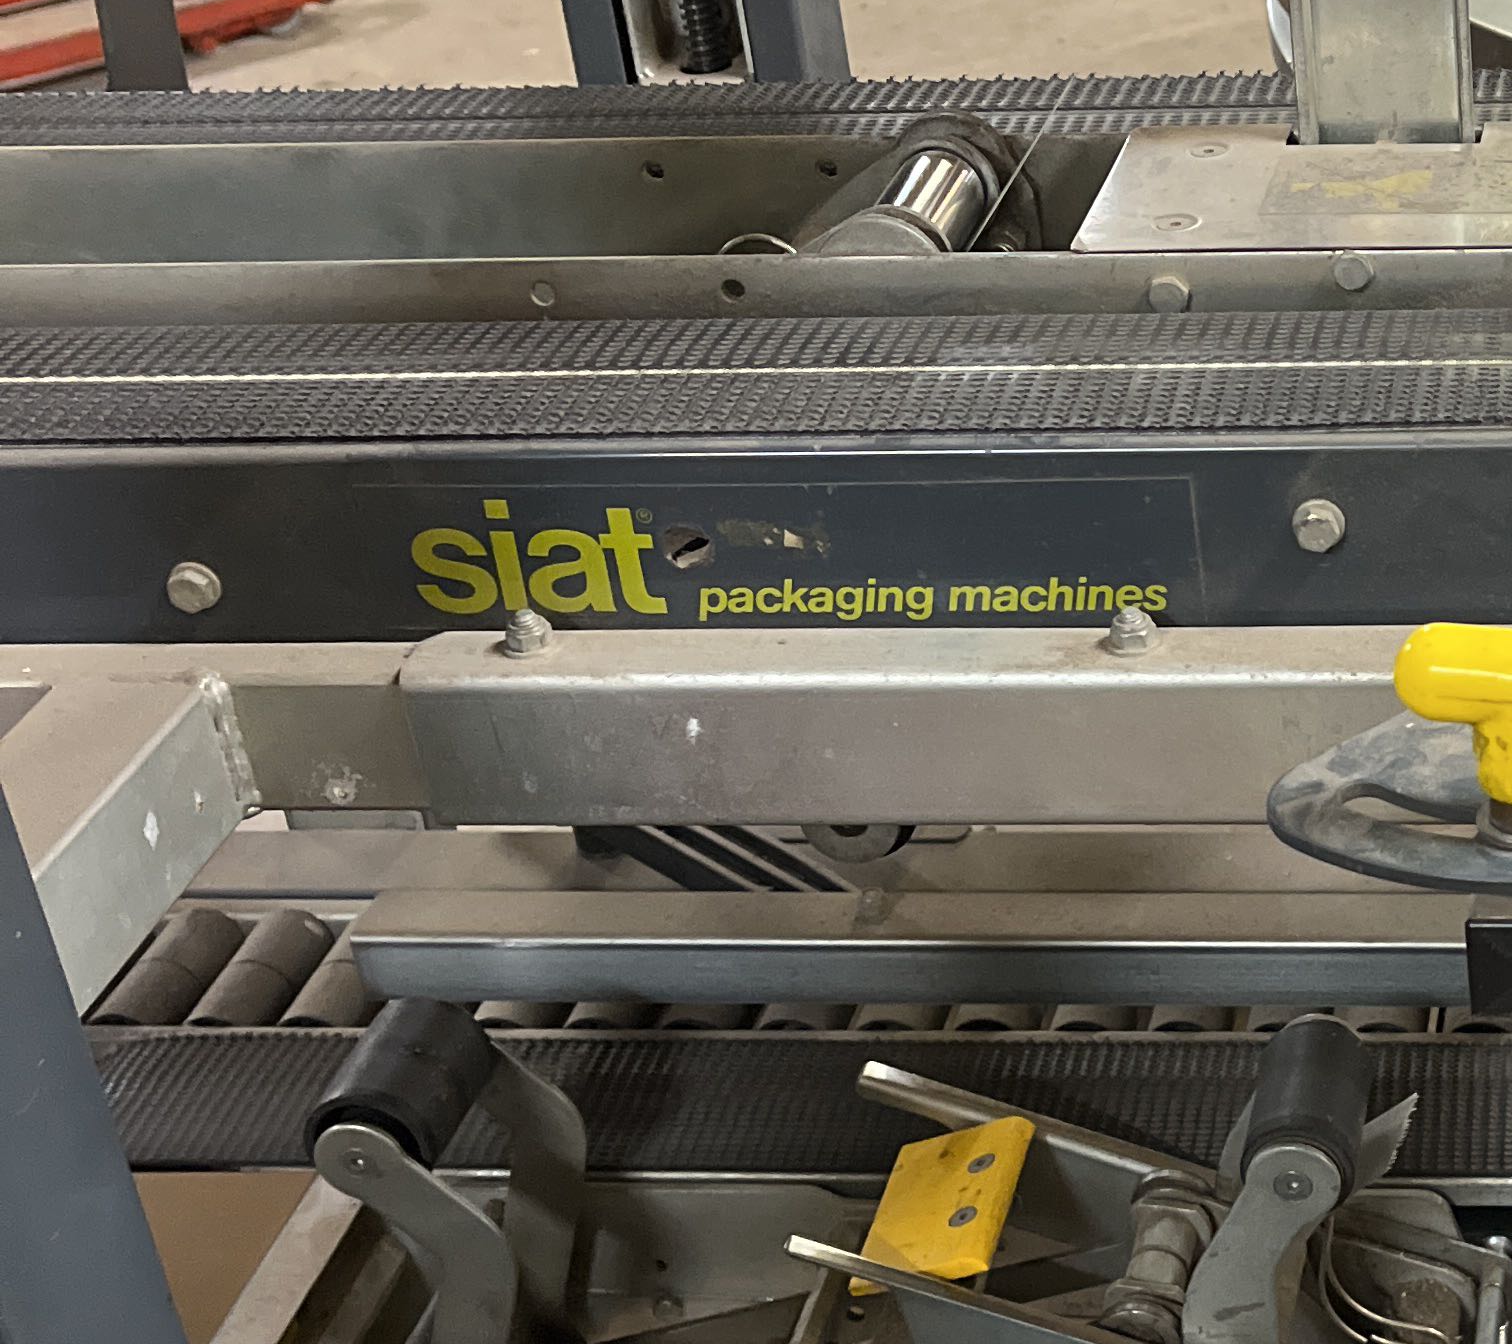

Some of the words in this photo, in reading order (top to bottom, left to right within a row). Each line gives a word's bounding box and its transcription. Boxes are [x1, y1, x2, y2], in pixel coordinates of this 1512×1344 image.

[411, 499, 668, 614] siat
[699, 578, 934, 621] packaging
[948, 577, 1168, 612] machines
